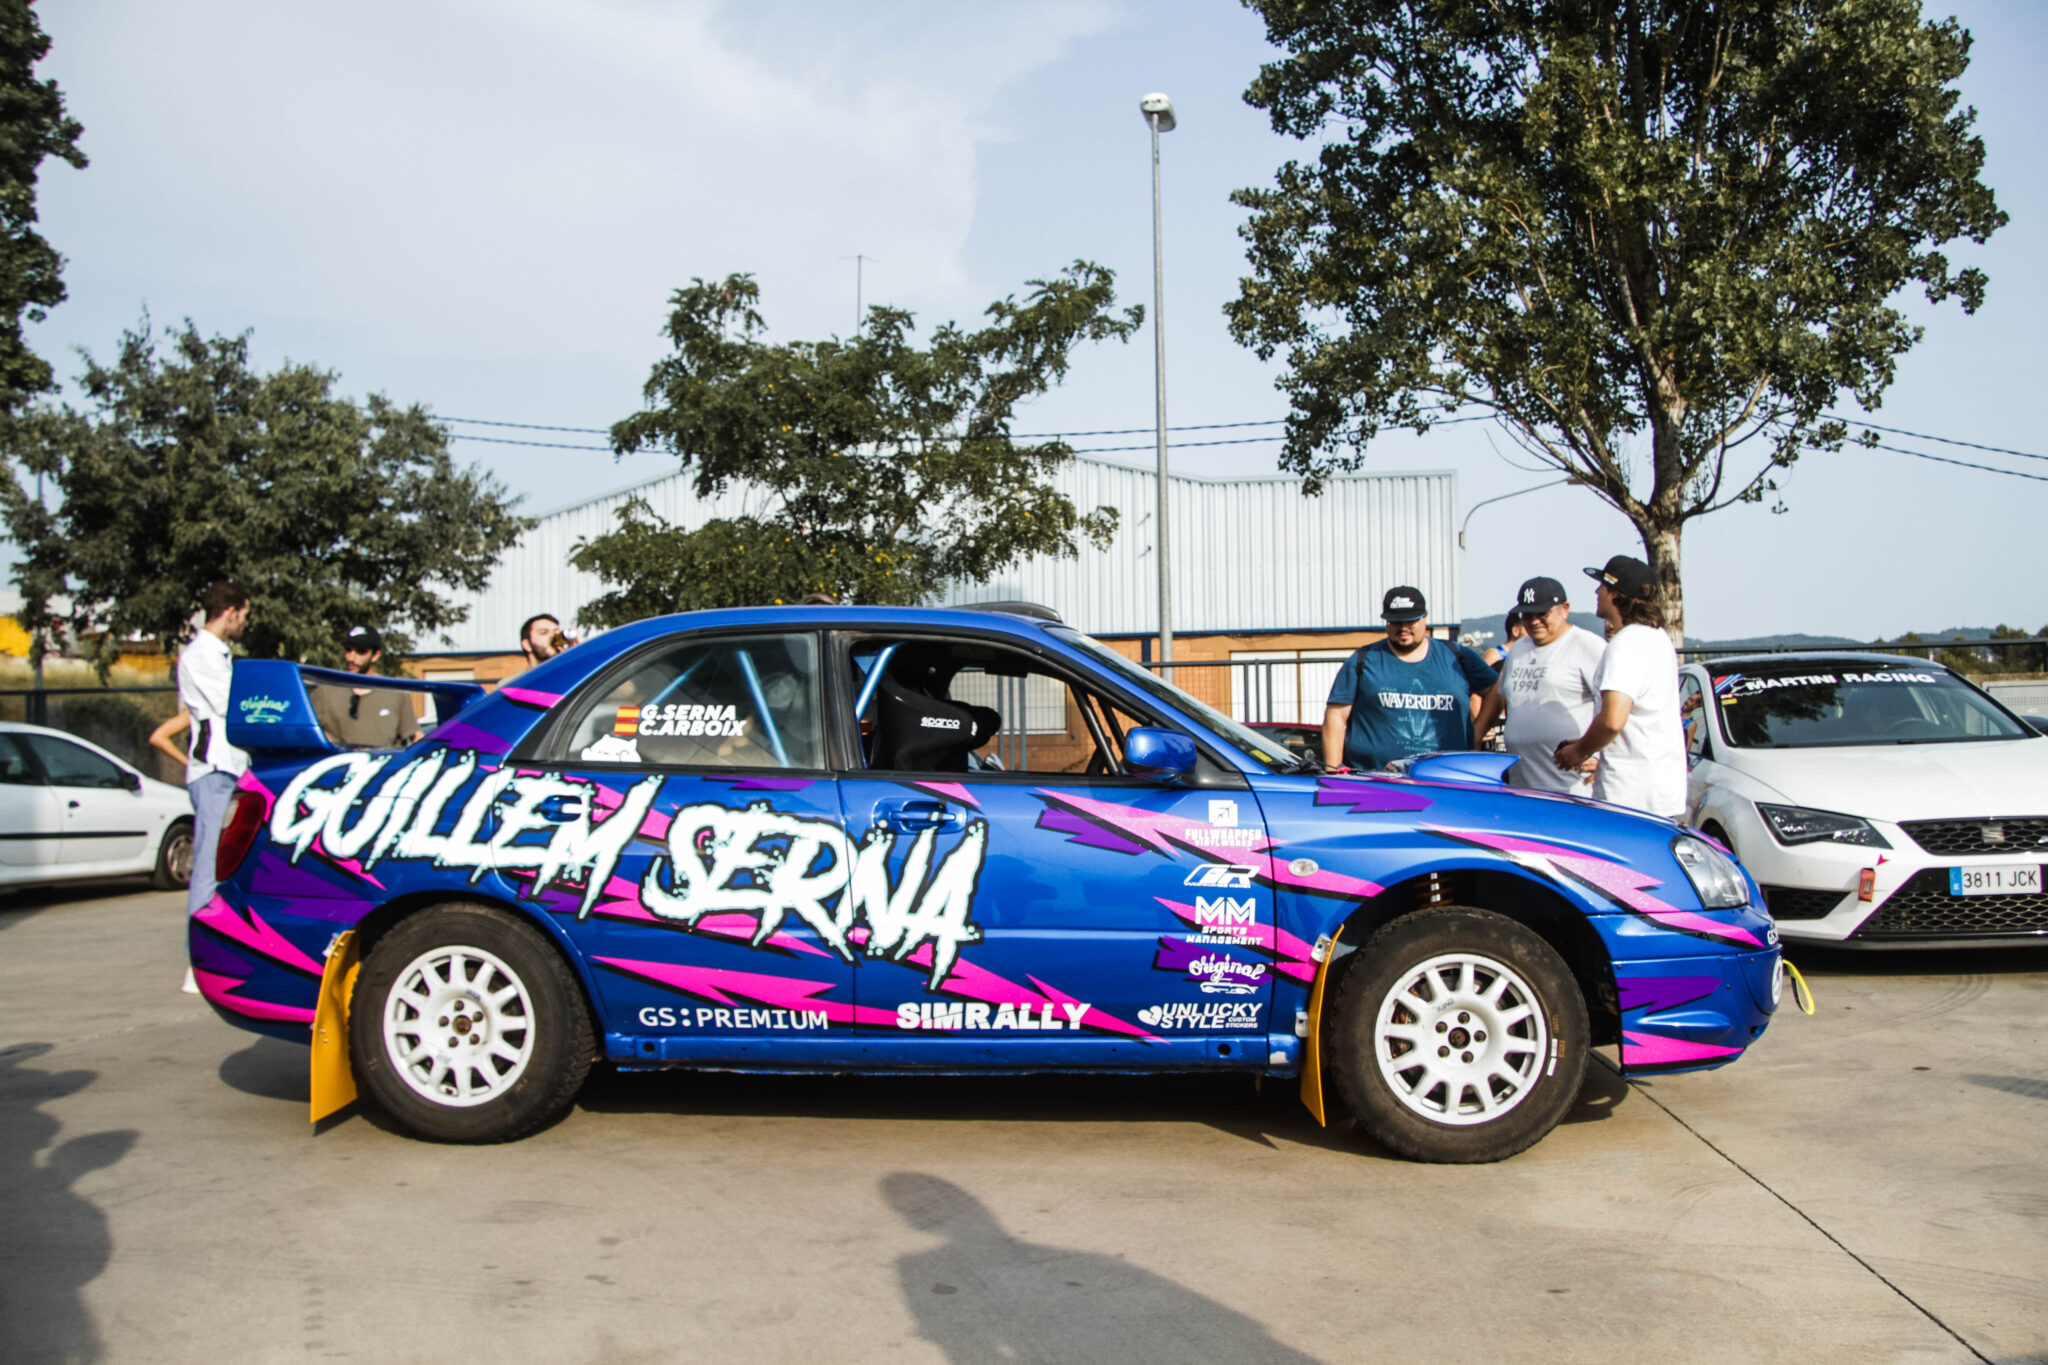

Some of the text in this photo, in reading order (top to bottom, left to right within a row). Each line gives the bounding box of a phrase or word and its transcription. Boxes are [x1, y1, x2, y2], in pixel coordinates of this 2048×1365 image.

[1512, 667, 1547, 679] SINCE
[1513, 680, 1539, 692] 1994
[1745, 673, 1936, 690] MARTINI RACING
[1378, 692, 1454, 711] WAVERIDER
[641, 704, 736, 720] G.SERNA
[638, 720, 747, 736] C.ARBOIX
[271, 747, 985, 990] GUILLEM SERNA
[1964, 872, 2000, 888] 3811
[2009, 871, 2036, 886] JCK
[1195, 896, 1256, 926] MM
[1202, 926, 1247, 935] SPORTS
[638, 1007, 828, 1029] GS:PREMIUM
[896, 1002, 1091, 1030] SIMRALLY
[1162, 1003, 1262, 1017] UNLUCKY
[1160, 1015, 1224, 1028] STYLE
